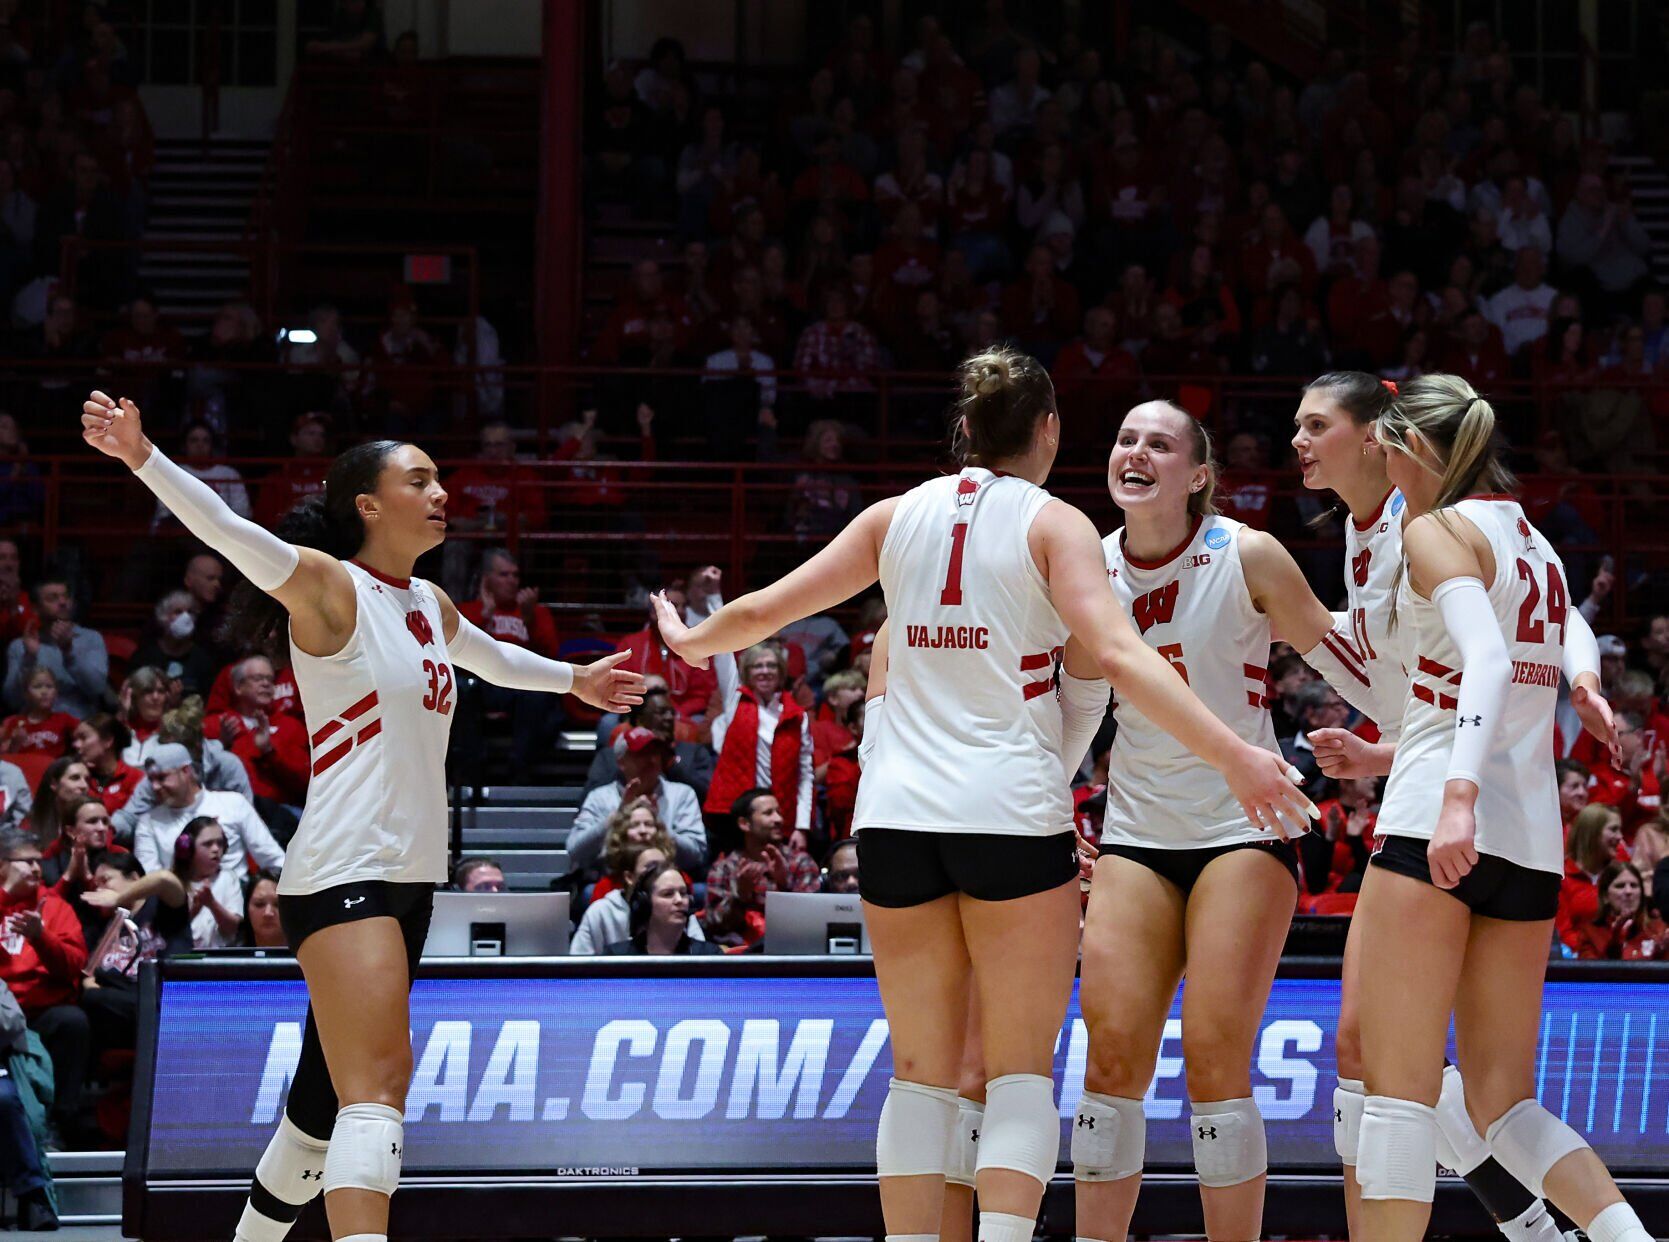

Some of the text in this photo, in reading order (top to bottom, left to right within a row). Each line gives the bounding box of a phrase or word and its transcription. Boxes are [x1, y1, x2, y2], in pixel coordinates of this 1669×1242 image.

[940, 523, 968, 606] 1
[1515, 557, 1568, 646] 24
[906, 625, 989, 650] VAJAGIC
[1353, 607, 1377, 661] 17
[422, 659, 453, 716] 32
[556, 1166, 639, 1176] DAKTRONICS
